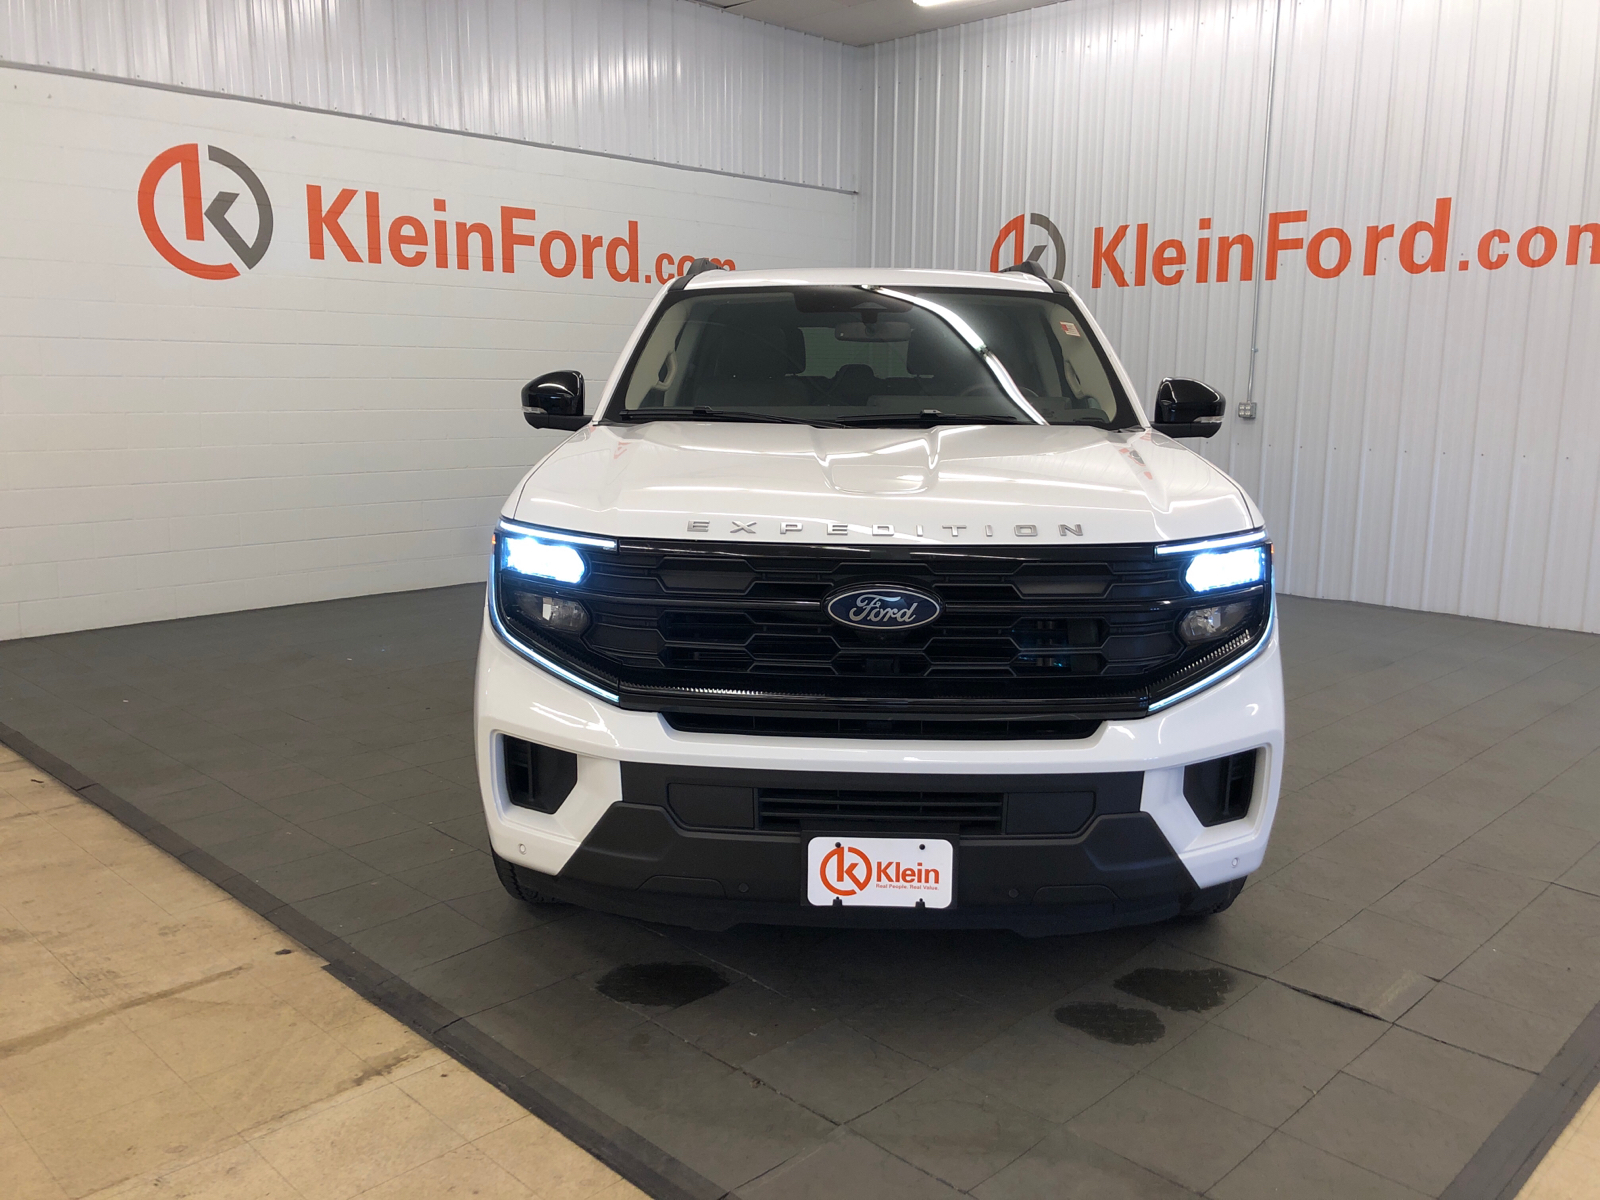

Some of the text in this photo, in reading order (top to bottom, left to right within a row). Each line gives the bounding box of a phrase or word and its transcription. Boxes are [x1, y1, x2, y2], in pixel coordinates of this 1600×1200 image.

[686, 519, 1084, 538] EXPEDITION
[848, 593, 916, 623] Ford
[876, 861, 940, 884] Klein
